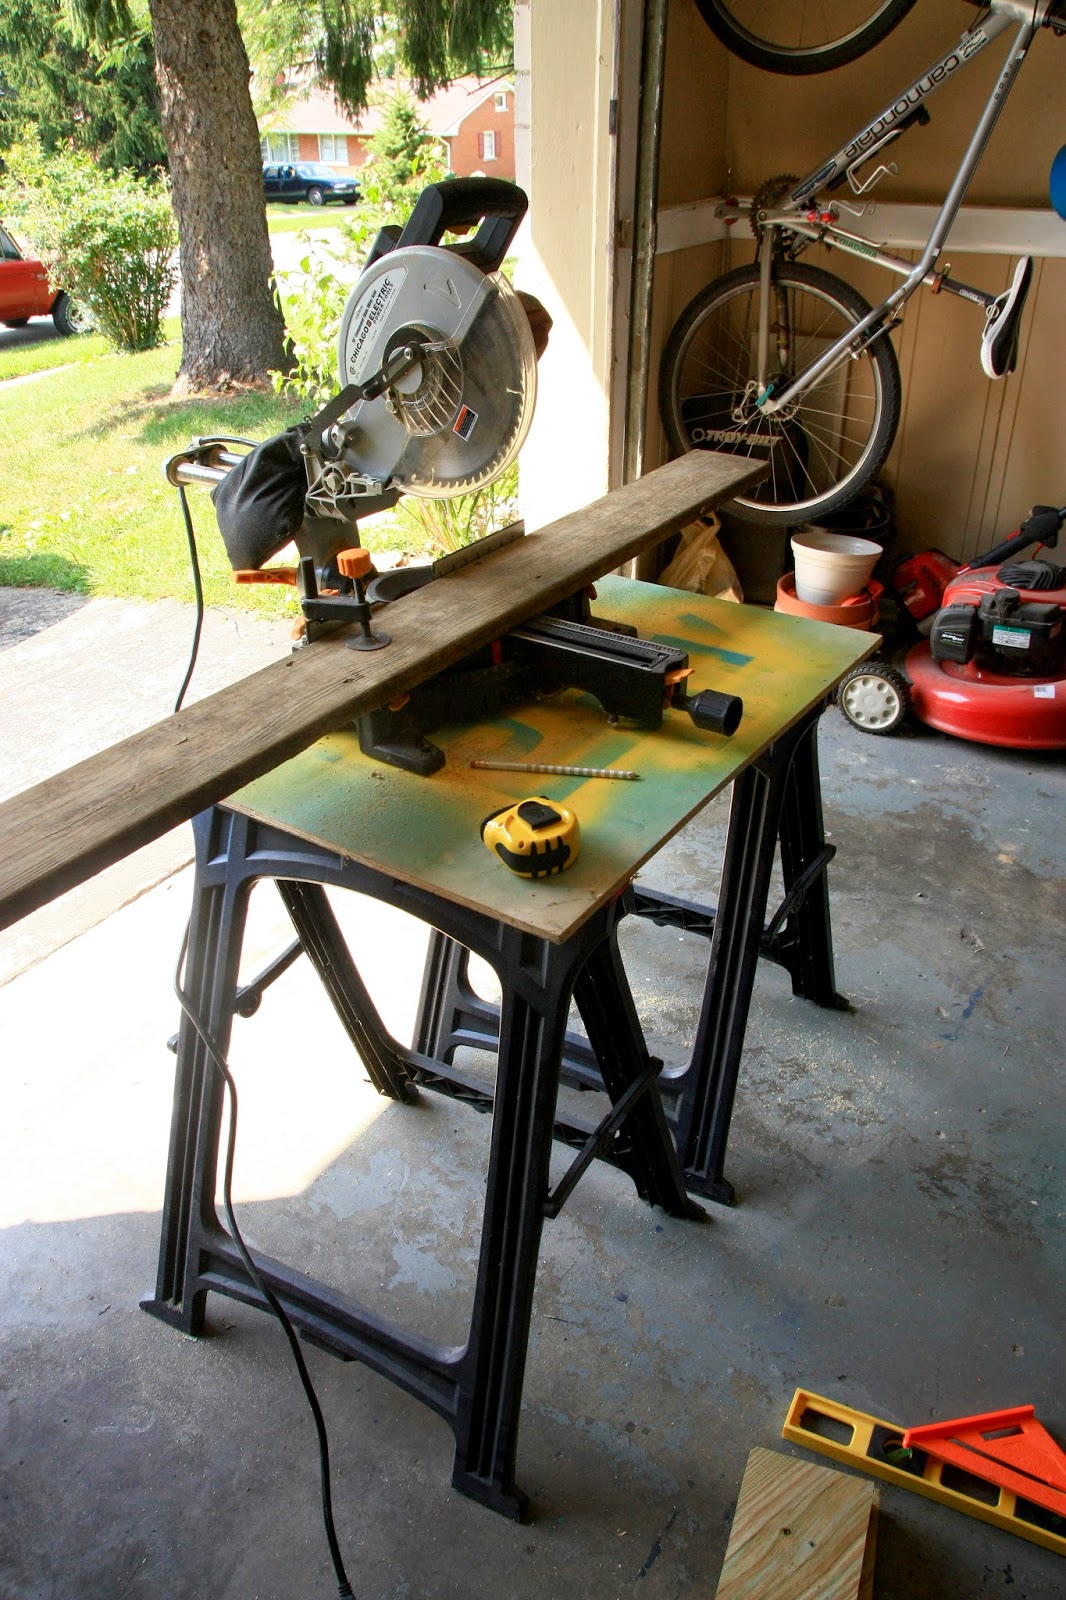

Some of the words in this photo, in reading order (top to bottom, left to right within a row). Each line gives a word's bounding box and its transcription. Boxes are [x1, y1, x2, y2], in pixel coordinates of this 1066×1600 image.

[843, 54, 960, 158] cannondale
[839, 238, 878, 260] DIADORA
[350, 326, 370, 364] CHICAGO
[368, 278, 391, 322] ELECTRIC
[373, 304, 385, 324] POWER
[382, 283, 394, 303] TOOLS
[705, 429, 784, 448] TROY-BILT
